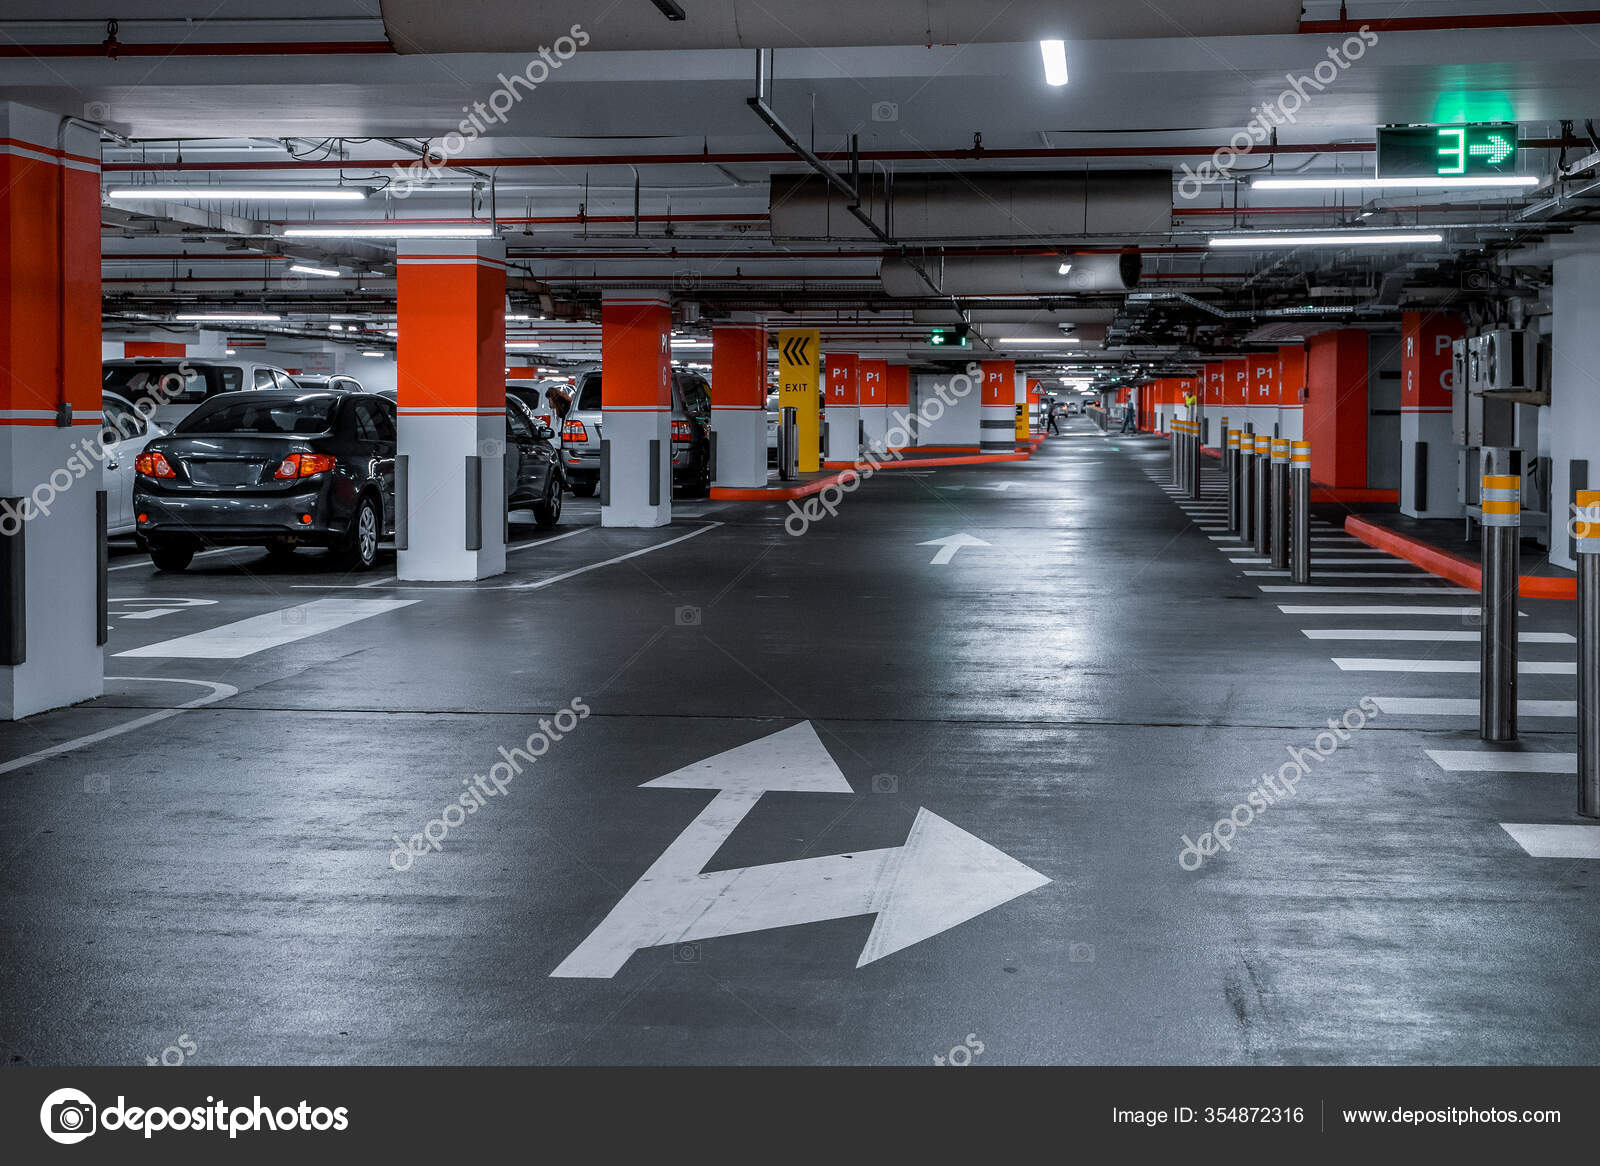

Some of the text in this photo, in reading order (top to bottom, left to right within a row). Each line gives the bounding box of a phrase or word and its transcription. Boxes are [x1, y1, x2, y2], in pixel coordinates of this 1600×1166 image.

[1438, 129, 1464, 173] 3
[1435, 335, 1452, 356] P
[833, 368, 848, 379] P1
[866, 372, 880, 382] P1
[990, 373, 1002, 383] P1
[1257, 368, 1272, 379] P1
[785, 384, 808, 392] EXIT
[835, 385, 845, 396] H
[1260, 384, 1269, 396] H
